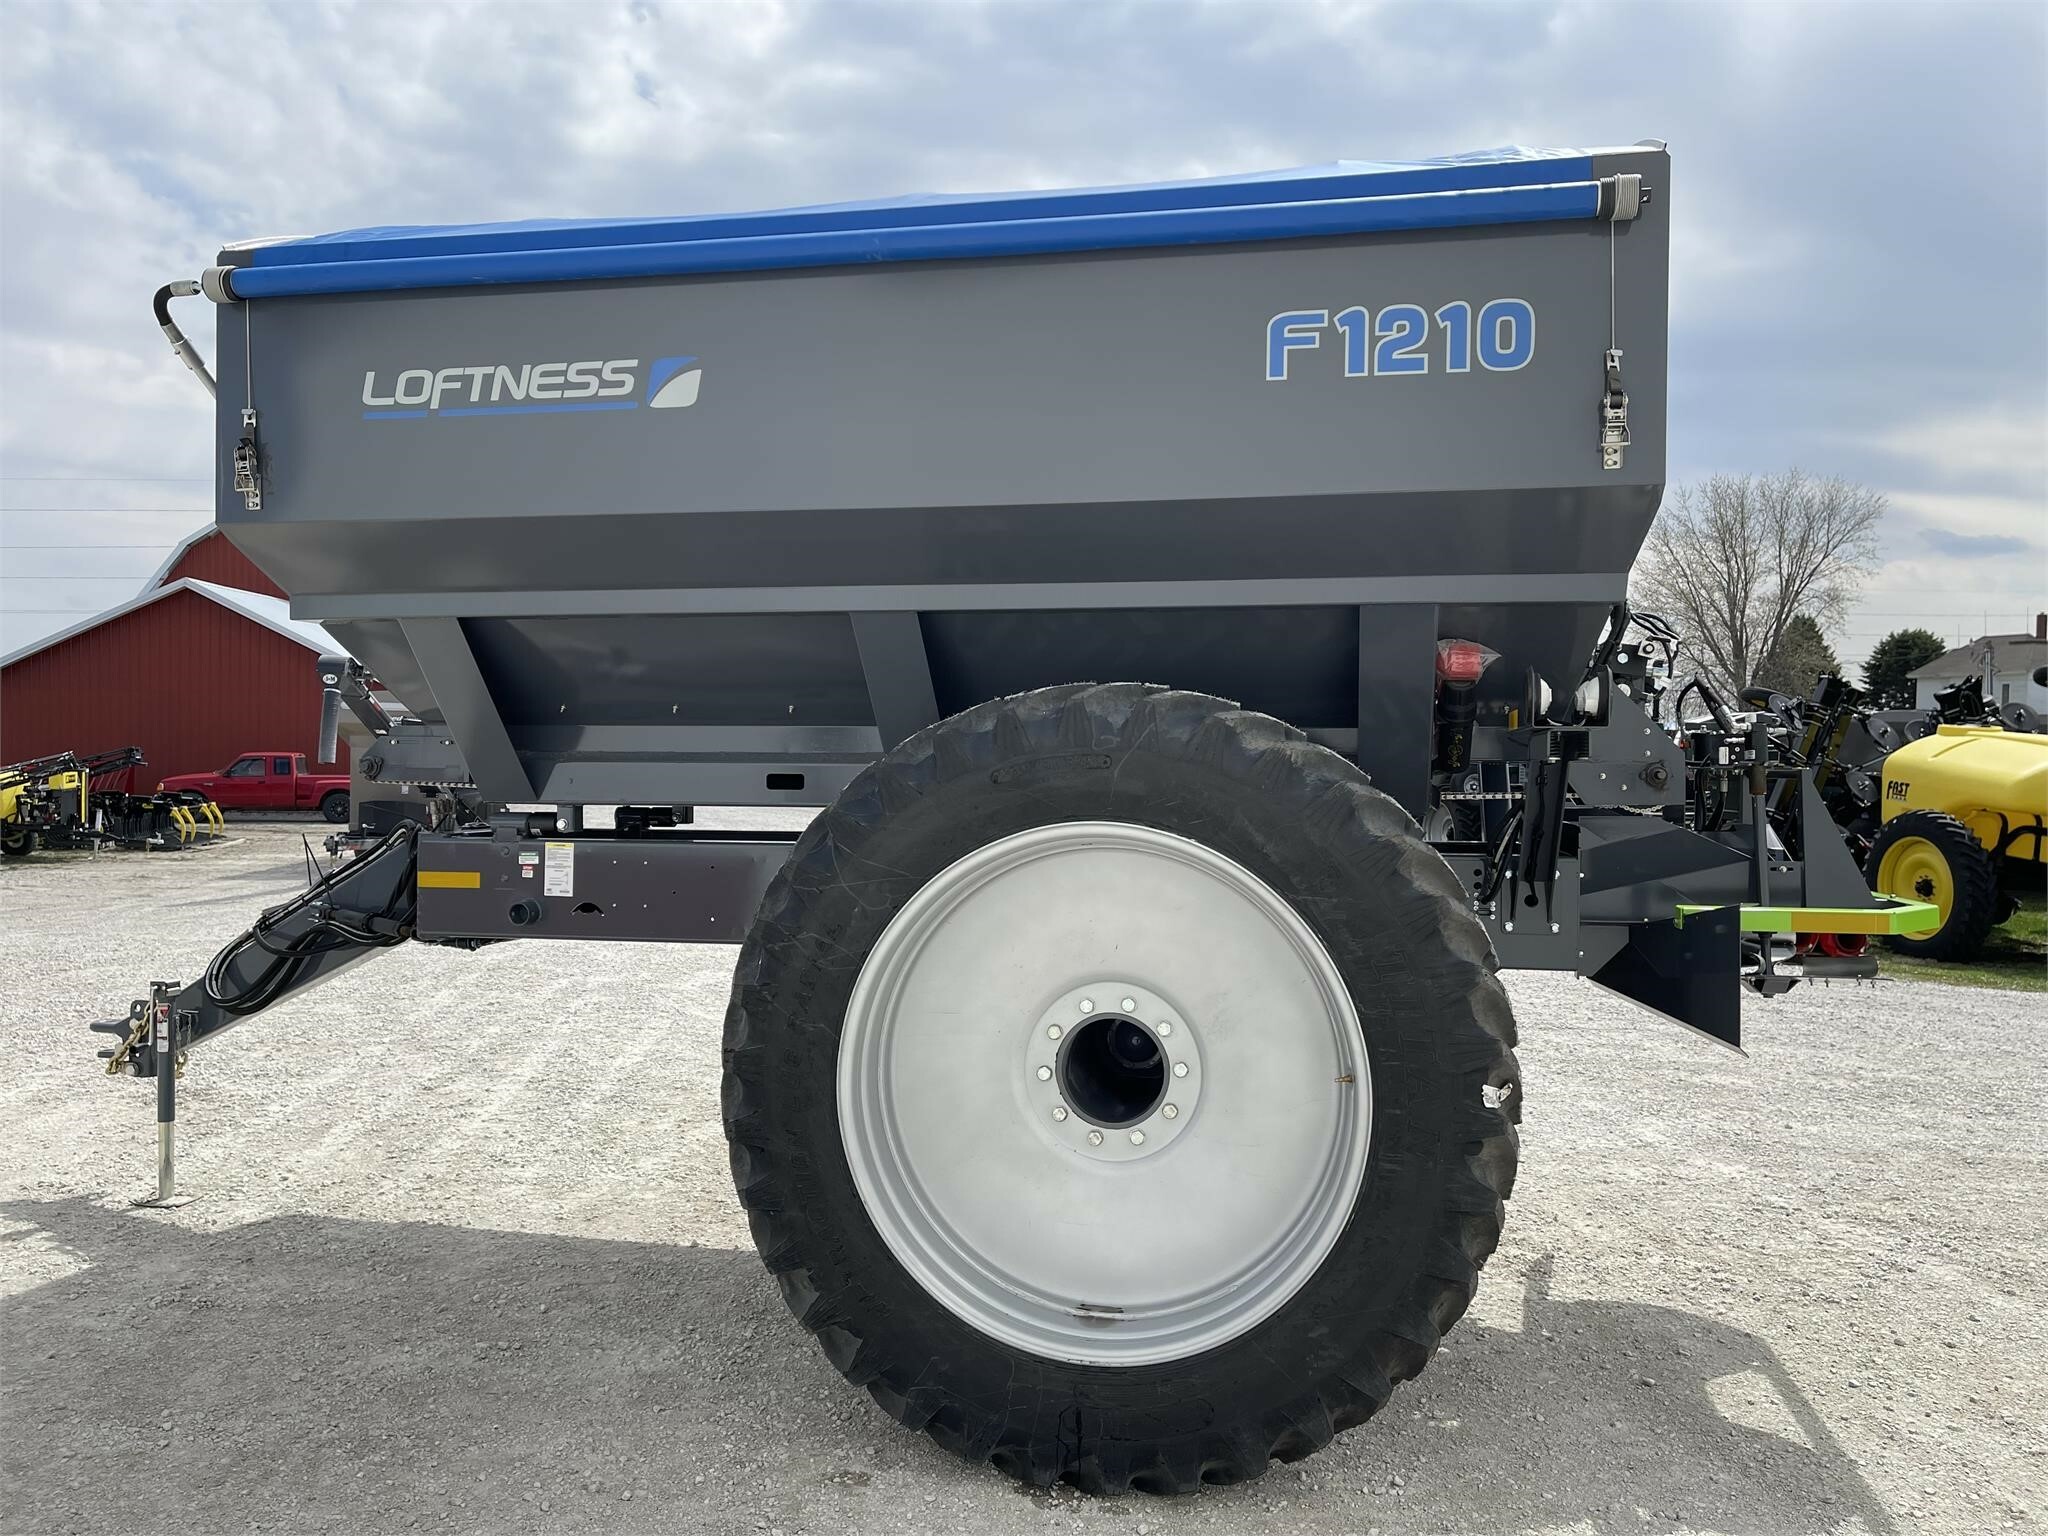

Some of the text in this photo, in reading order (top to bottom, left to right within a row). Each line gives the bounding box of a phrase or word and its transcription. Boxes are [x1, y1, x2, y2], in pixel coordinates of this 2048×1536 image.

[1266, 298, 1536, 381] F1210
[362, 359, 639, 409] LOFTNESS
[1886, 780, 1910, 800] FAST
